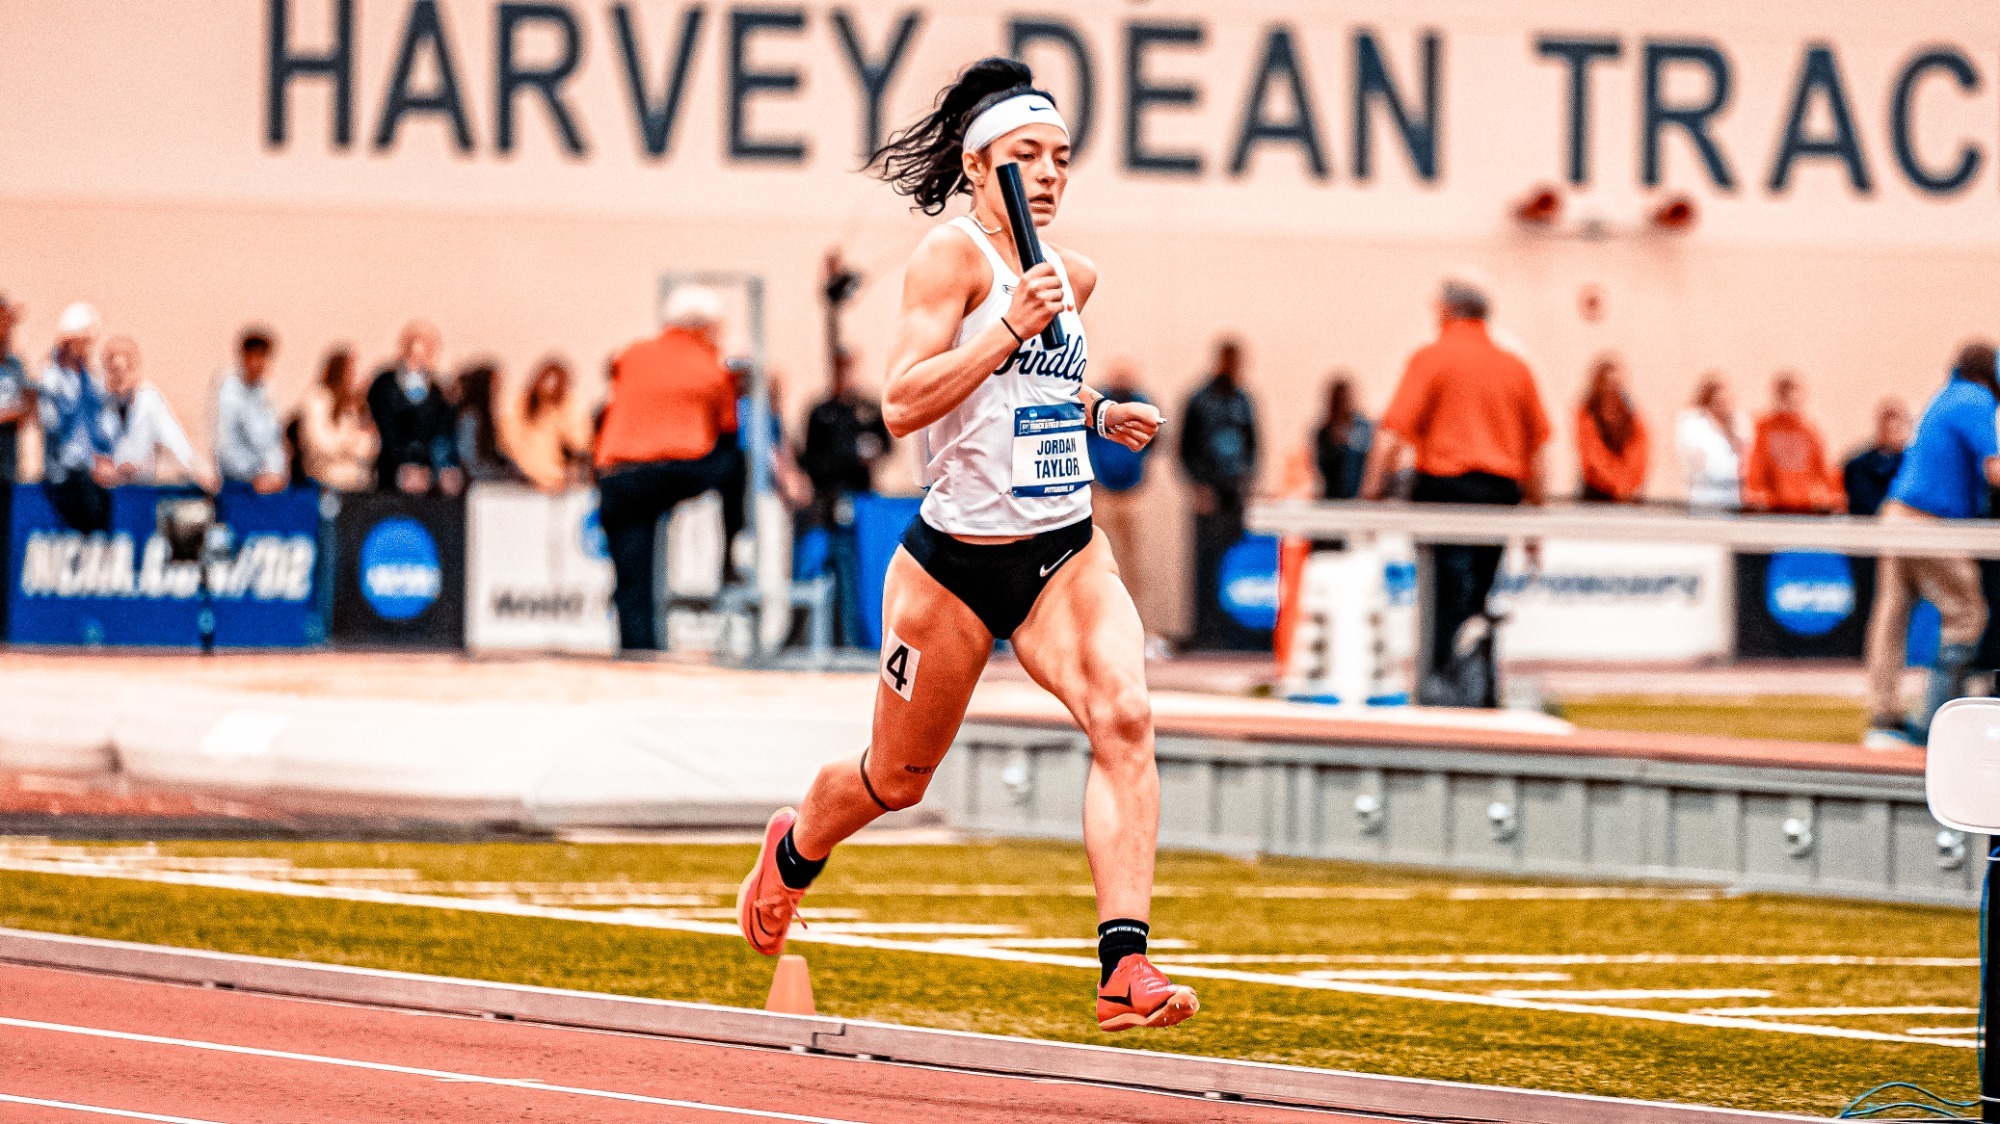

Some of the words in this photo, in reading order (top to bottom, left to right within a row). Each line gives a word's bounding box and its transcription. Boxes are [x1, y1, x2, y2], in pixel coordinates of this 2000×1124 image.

[265, 0, 922, 163] HARVEY
[1009, 19, 1443, 183] DEAN
[1536, 36, 2000, 194] TRAC
[993, 334, 1087, 396] indla
[1034, 457, 1080, 479] TAYLOR
[1037, 438, 1076, 455] JORDAN
[887, 644, 909, 691] 4
